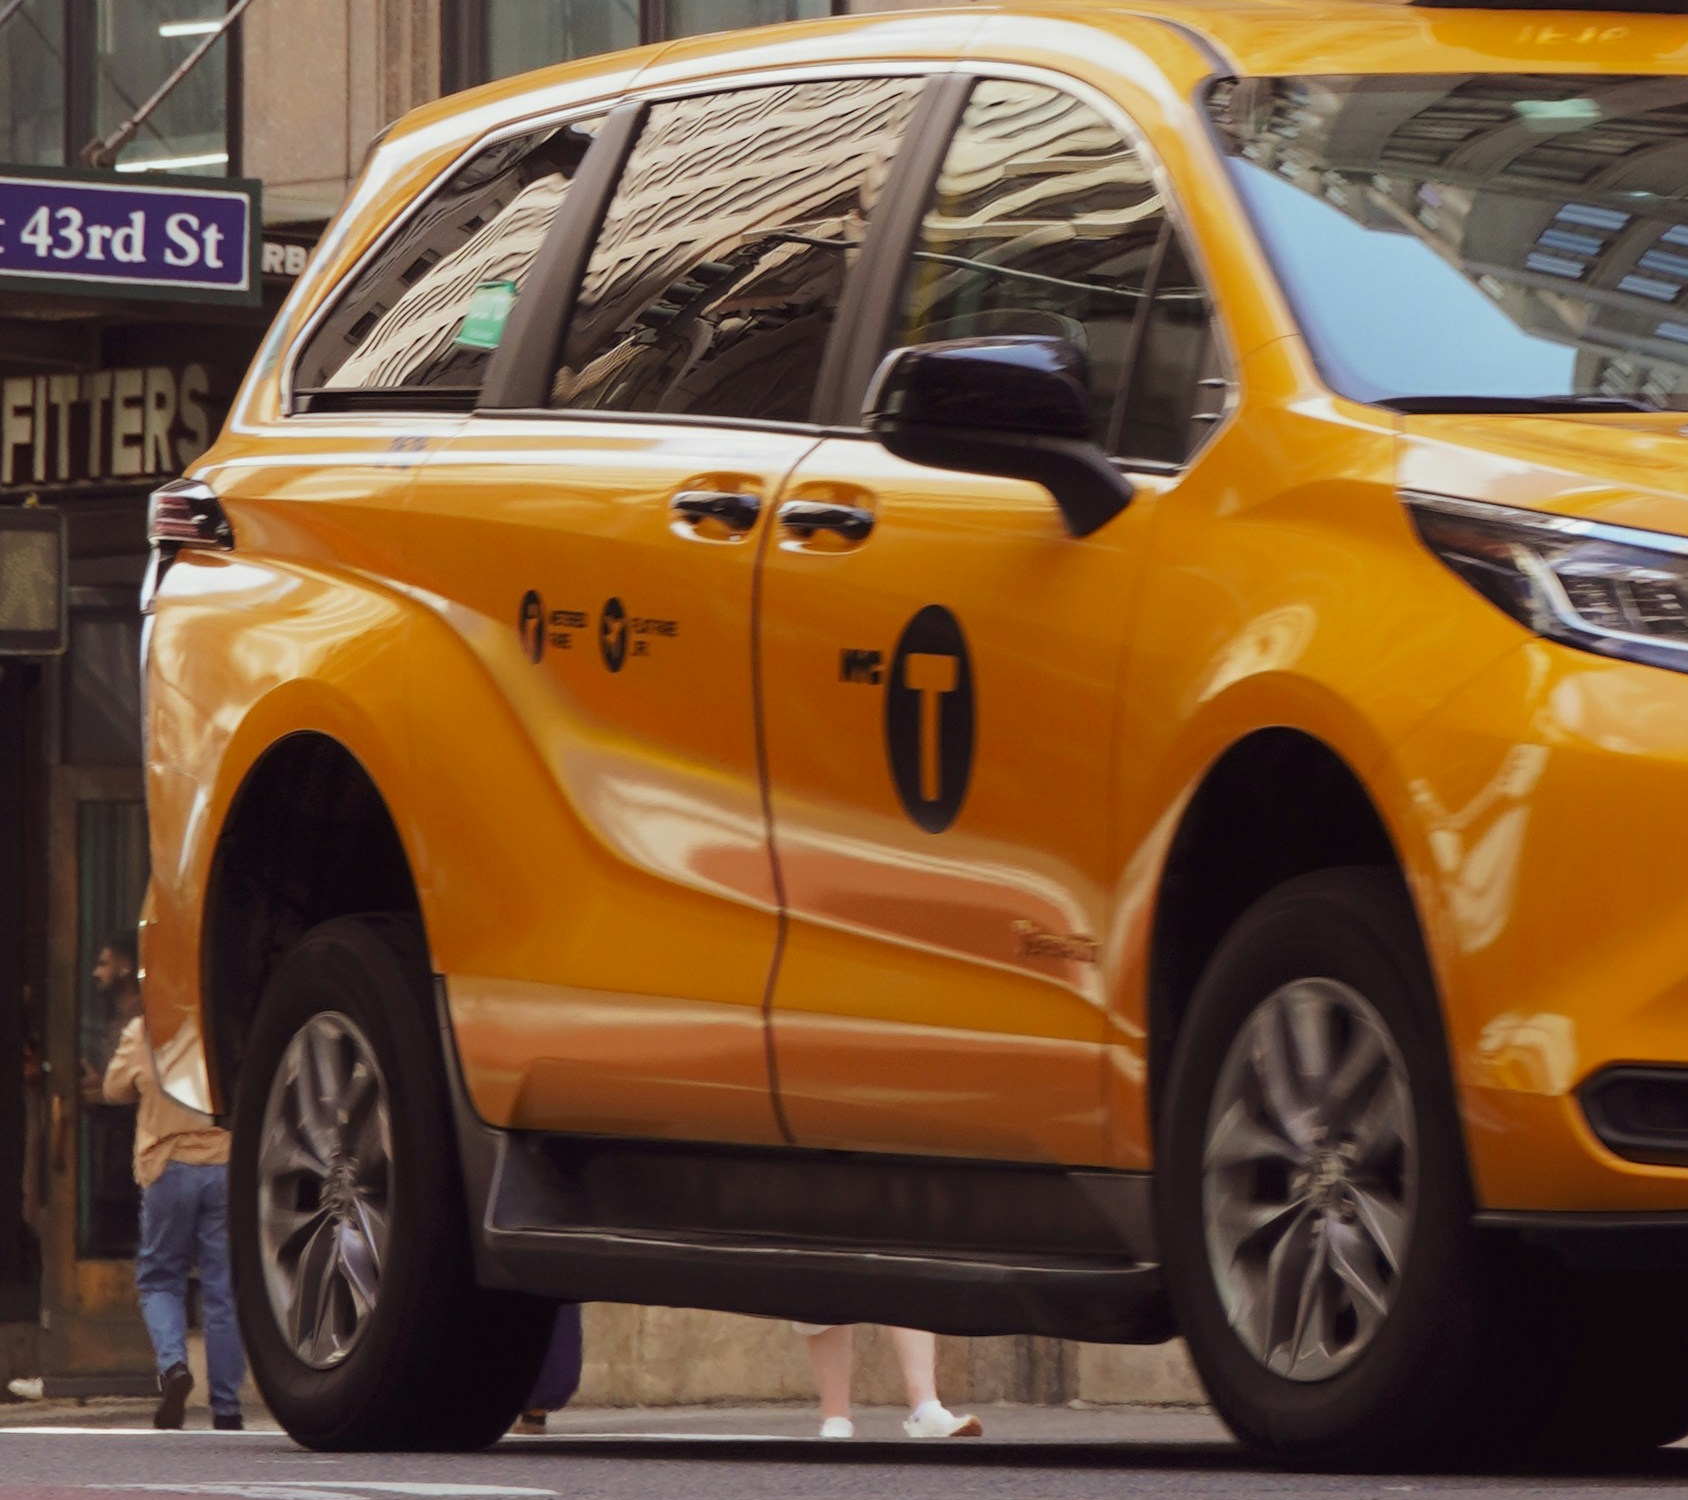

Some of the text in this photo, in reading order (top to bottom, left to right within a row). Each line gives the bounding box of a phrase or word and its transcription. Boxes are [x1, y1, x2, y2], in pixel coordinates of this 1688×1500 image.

[20, 206, 147, 263] 43rd
[163, 212, 224, 268] St
[2, 362, 209, 484] FITTERS
